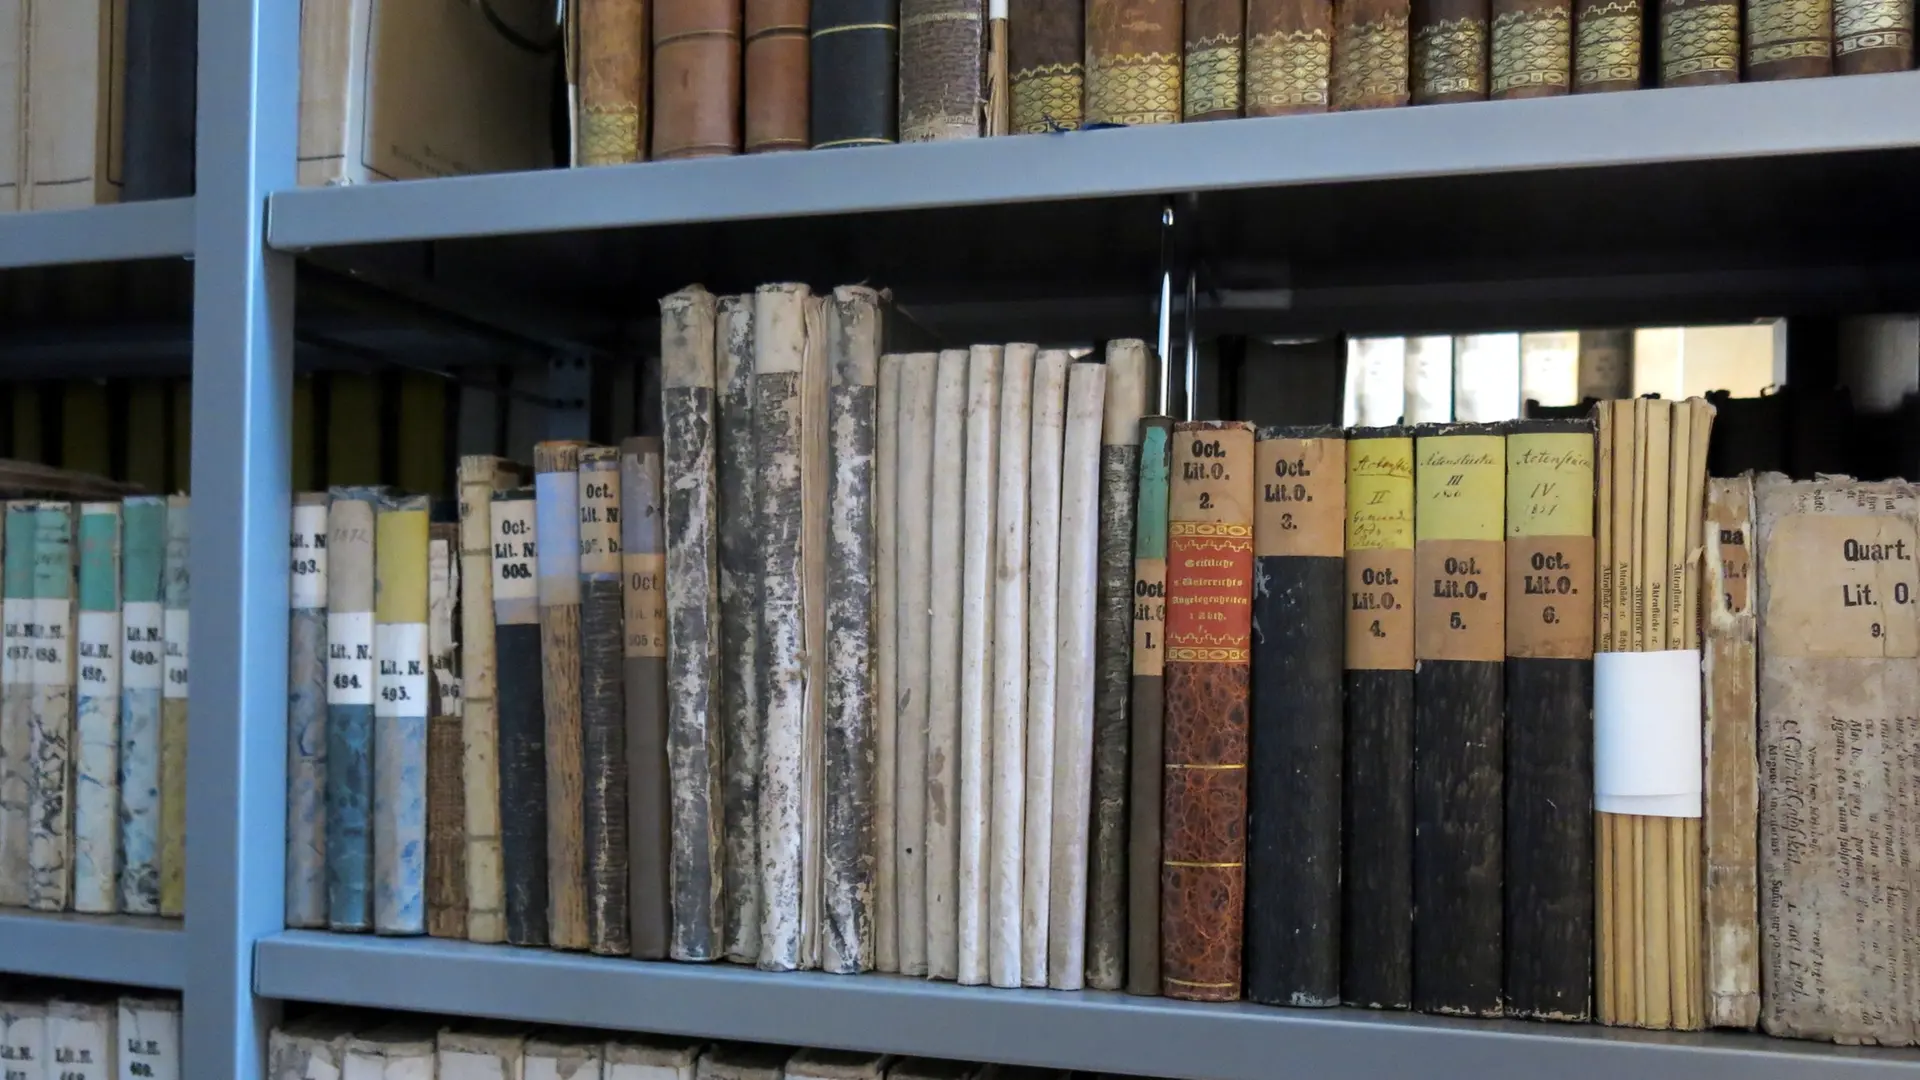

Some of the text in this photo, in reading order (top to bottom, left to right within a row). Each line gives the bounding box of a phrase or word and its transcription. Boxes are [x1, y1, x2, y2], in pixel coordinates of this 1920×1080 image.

[1192, 440, 1226, 458] Oct.
[1275, 459, 1311, 477] Oct.
[586, 483, 614, 499] Oct.
[1199, 492, 1214, 509] 2.
[581, 507, 602, 523] Lit.
[1281, 513, 1297, 530] 3.
[495, 543, 518, 559] Lit.
[1844, 539, 1911, 561] Quart.
[1444, 556, 1481, 575] Oct.
[1531, 552, 1571, 570] Oct.
[1362, 568, 1399, 585] Oct.
[1843, 582, 1915, 607] Lit. O.
[1450, 612, 1467, 629] 5.
[1542, 606, 1560, 624] 6.
[1369, 620, 1386, 637] 4.
[1871, 623, 1884, 638] 9.
[330, 643, 373, 660] Lit. N.
[380, 659, 403, 676] Lit.
[408, 660, 424, 676] N.
[333, 673, 362, 689] 494.
